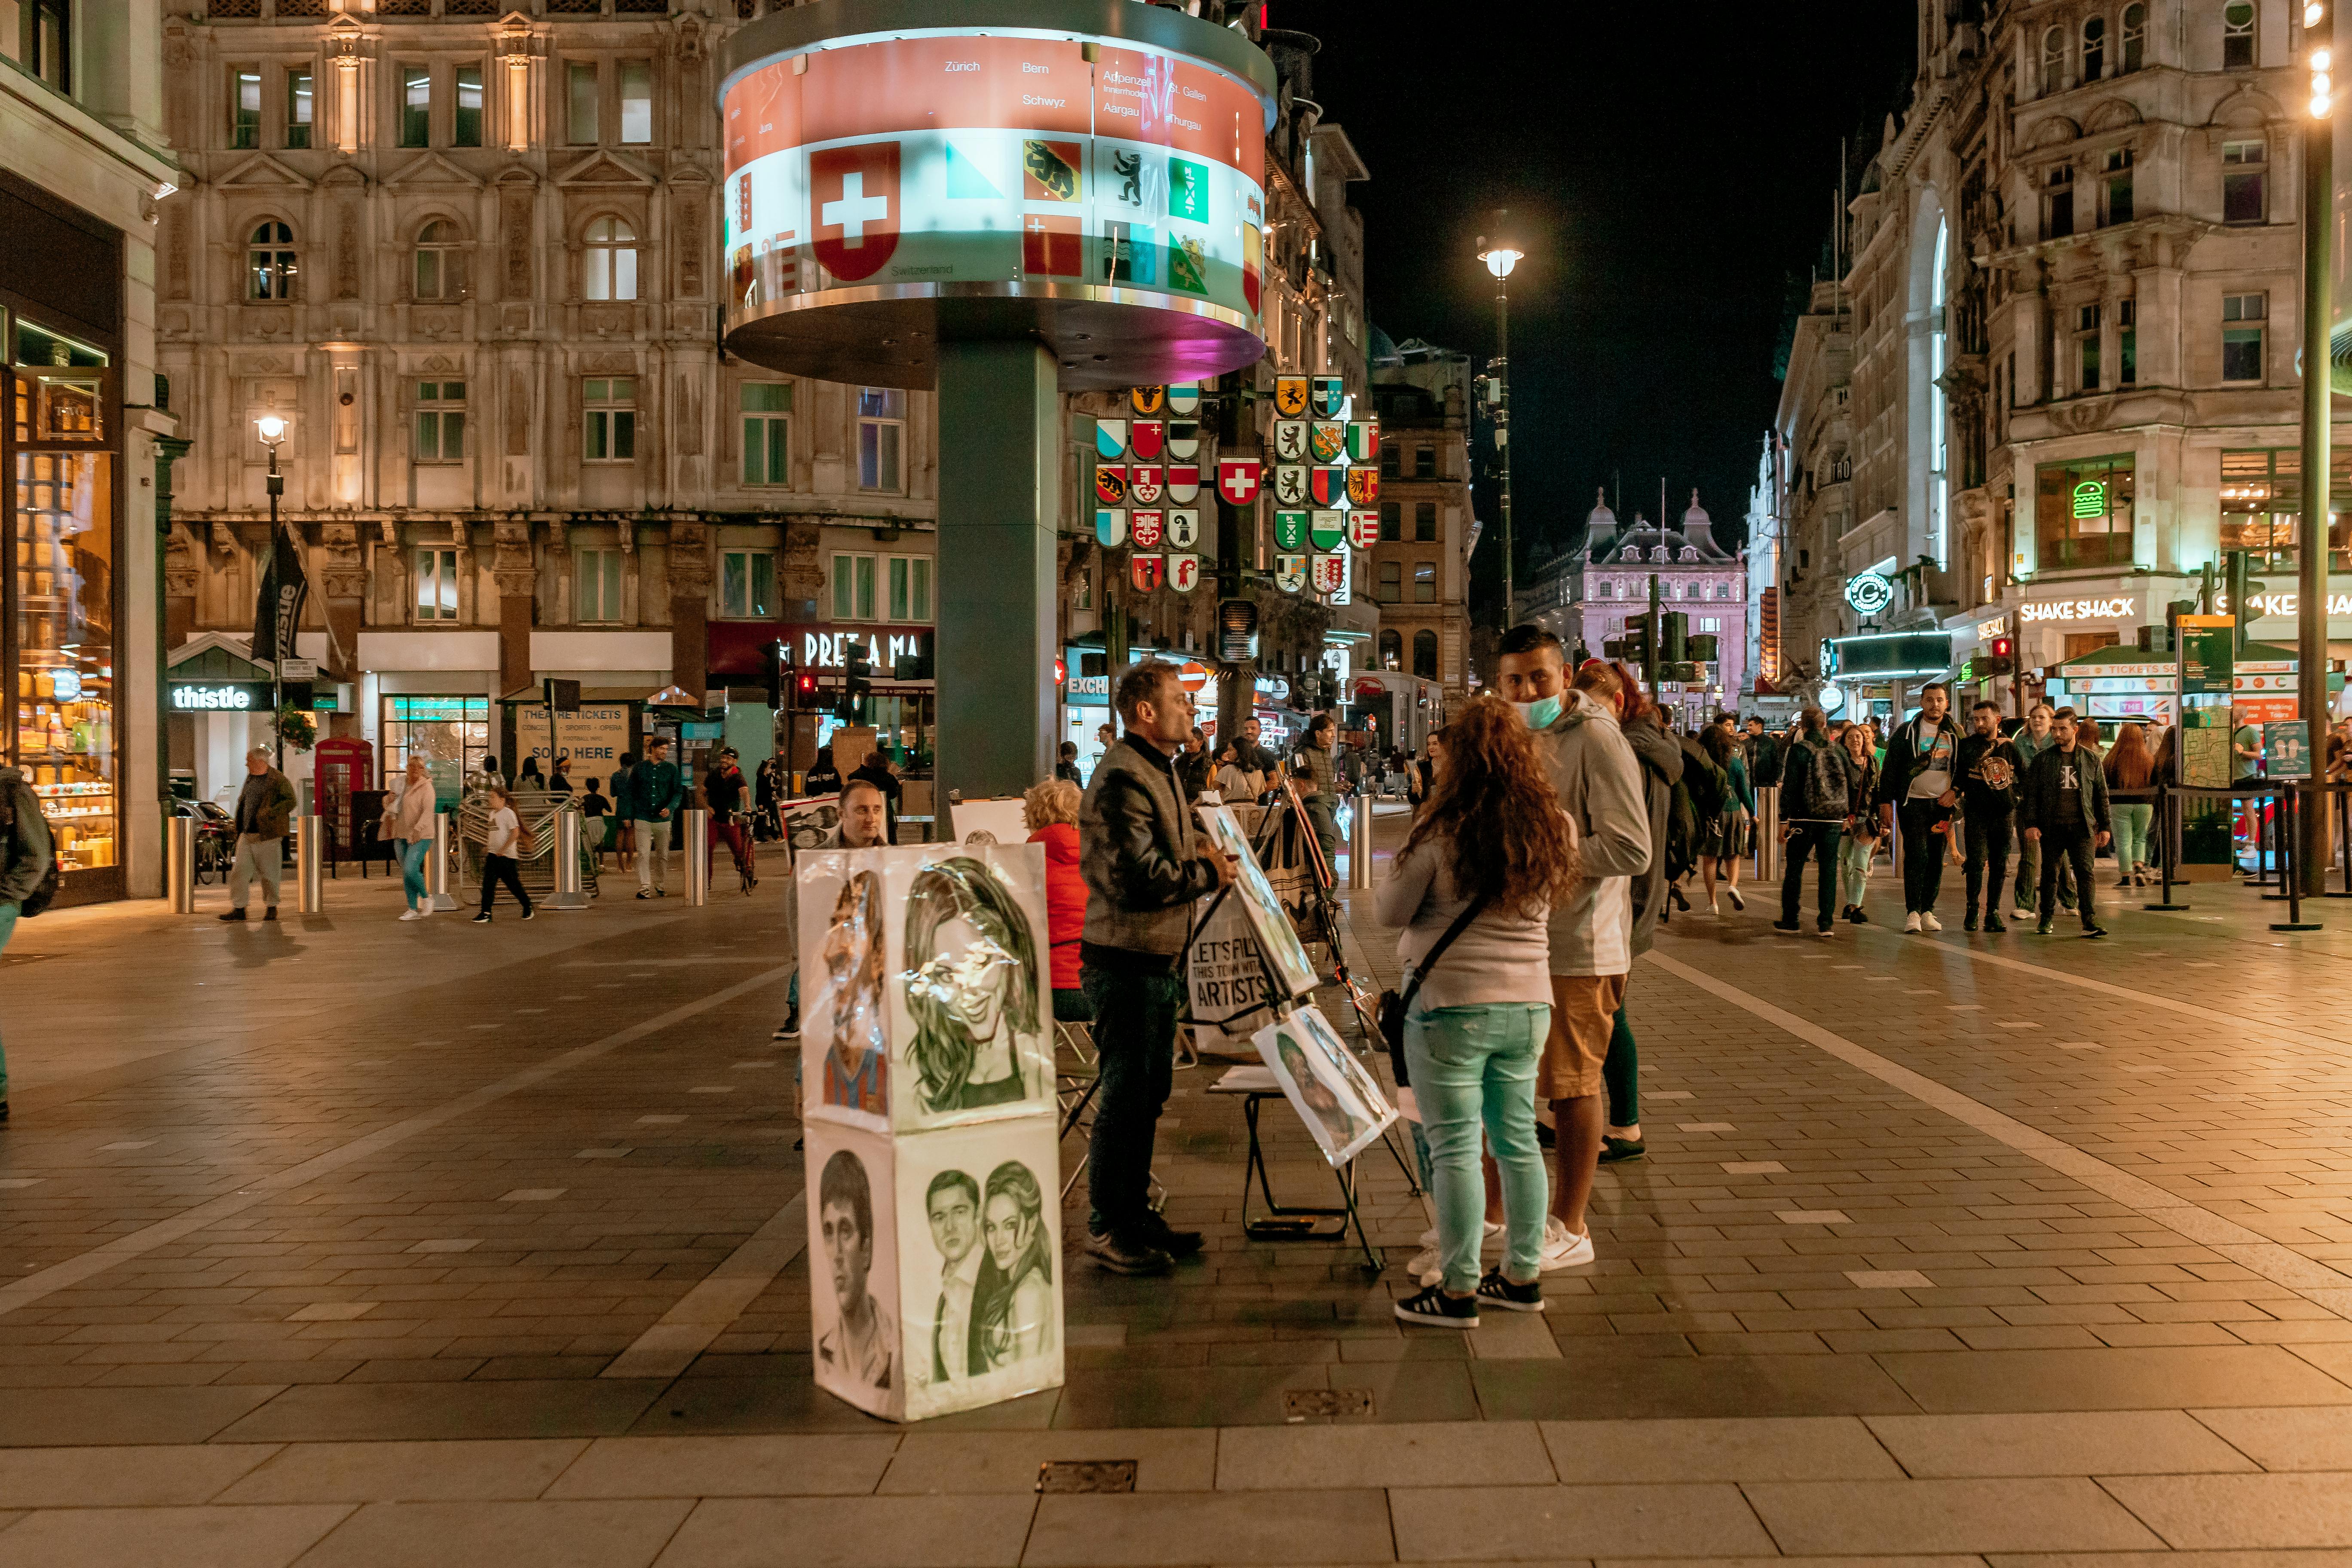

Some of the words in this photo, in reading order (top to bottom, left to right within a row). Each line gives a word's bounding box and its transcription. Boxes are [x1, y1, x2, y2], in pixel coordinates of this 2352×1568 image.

[945, 61, 980, 72] Zürich
[1022, 62, 1049, 74] Bern
[1103, 70, 1152, 88] Appenzell
[1023, 94, 1066, 109] Schwyz
[1182, 86, 1207, 102] Gallen
[1103, 102, 1139, 117] Aargau
[1168, 114, 1201, 131] Thurgau
[1852, 576, 1886, 593] GROSVENOR
[1859, 582, 1879, 603] G
[1855, 599, 1884, 610] CASINOS
[2021, 601, 2074, 622] SHAKE
[2076, 598, 2135, 619] SHACK
[2215, 594, 2297, 616] SAKE
[866, 634, 881, 668] A
[2109, 665, 2159, 674] TICKETS
[173, 686, 249, 708] thistle
[523, 710, 572, 719] THEARE
[576, 710, 622, 719] TICKETS
[532, 747, 570, 759] SOD
[574, 747, 613, 759] HERE
[1197, 975, 1268, 1007] ARTISTS
